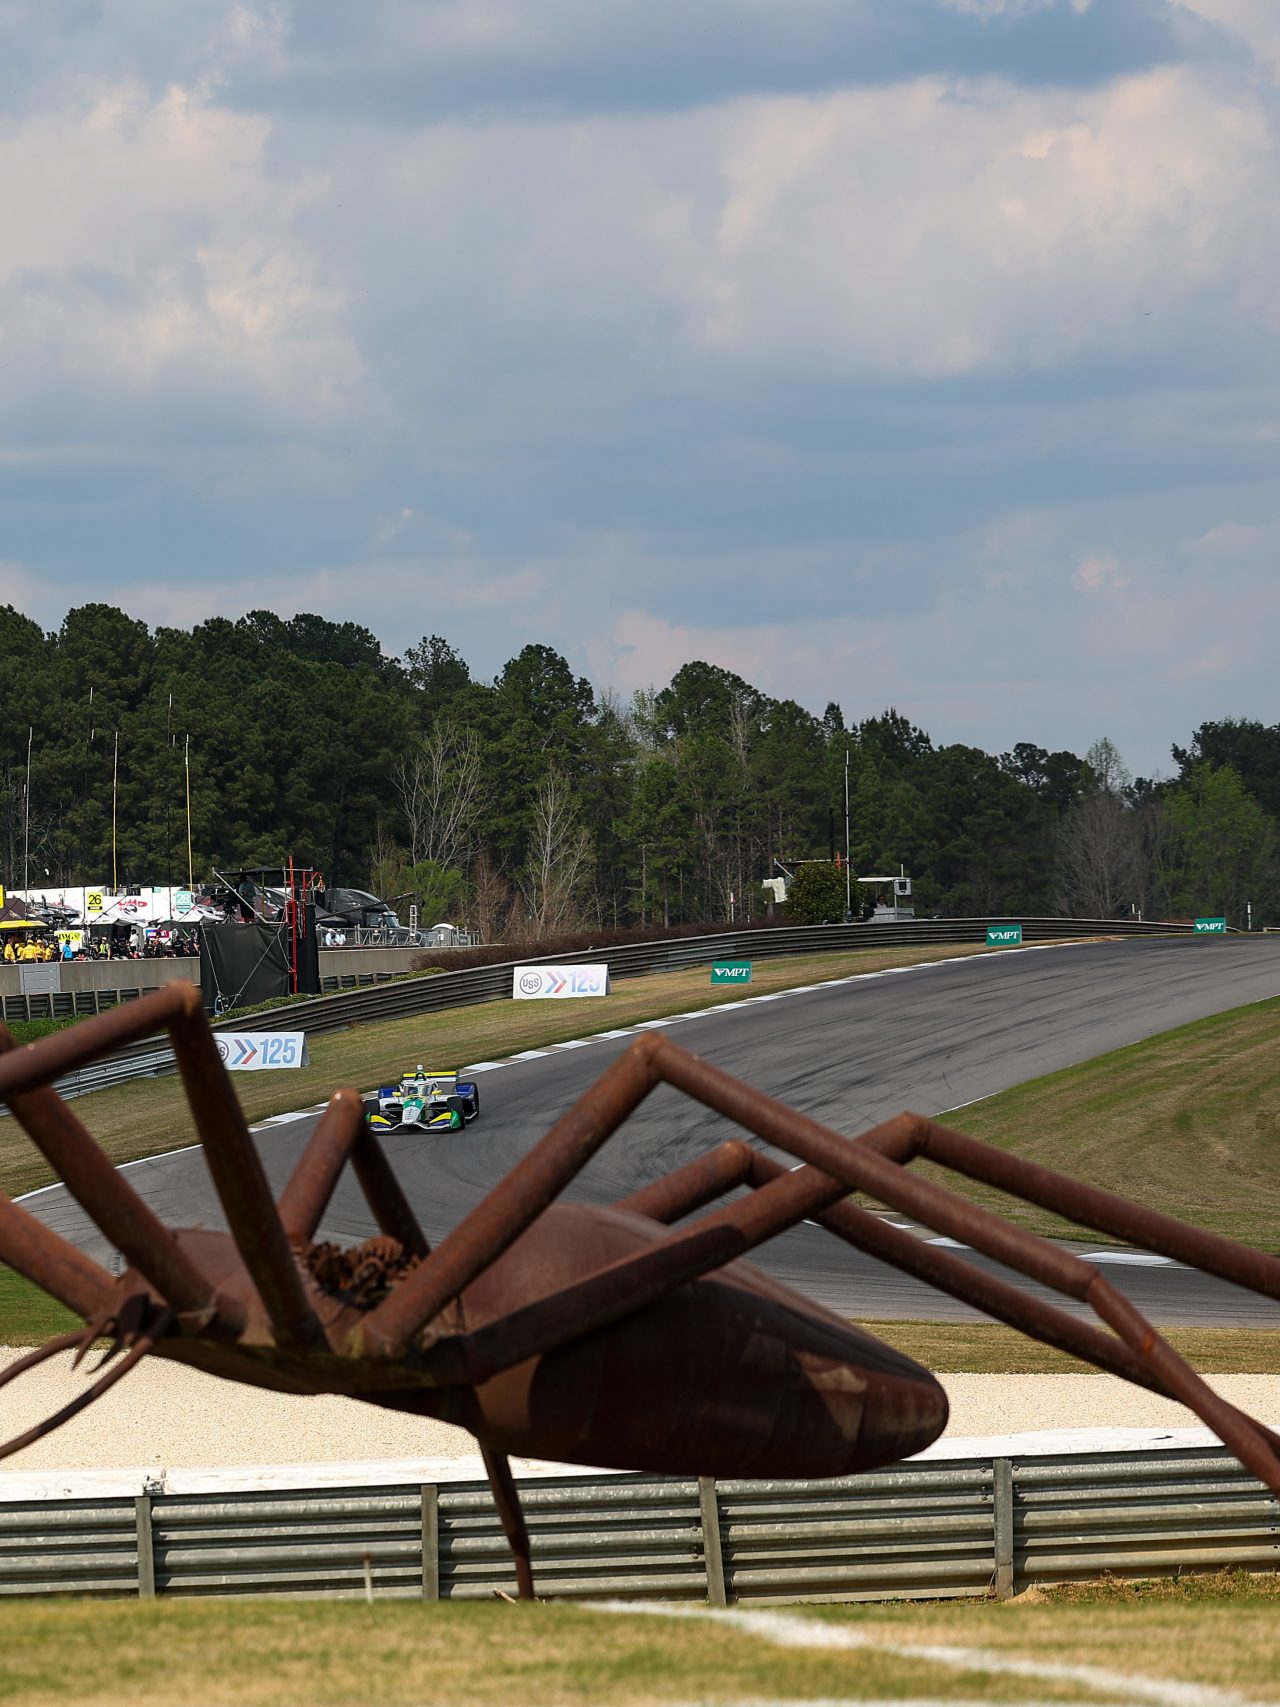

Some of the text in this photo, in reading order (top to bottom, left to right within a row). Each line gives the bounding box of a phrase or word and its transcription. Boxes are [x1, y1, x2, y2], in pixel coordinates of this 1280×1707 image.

[88, 894, 101, 905] 26
[176, 893, 190, 904] 28
[522, 977, 539, 989] USS
[260, 1038, 297, 1065] 125
